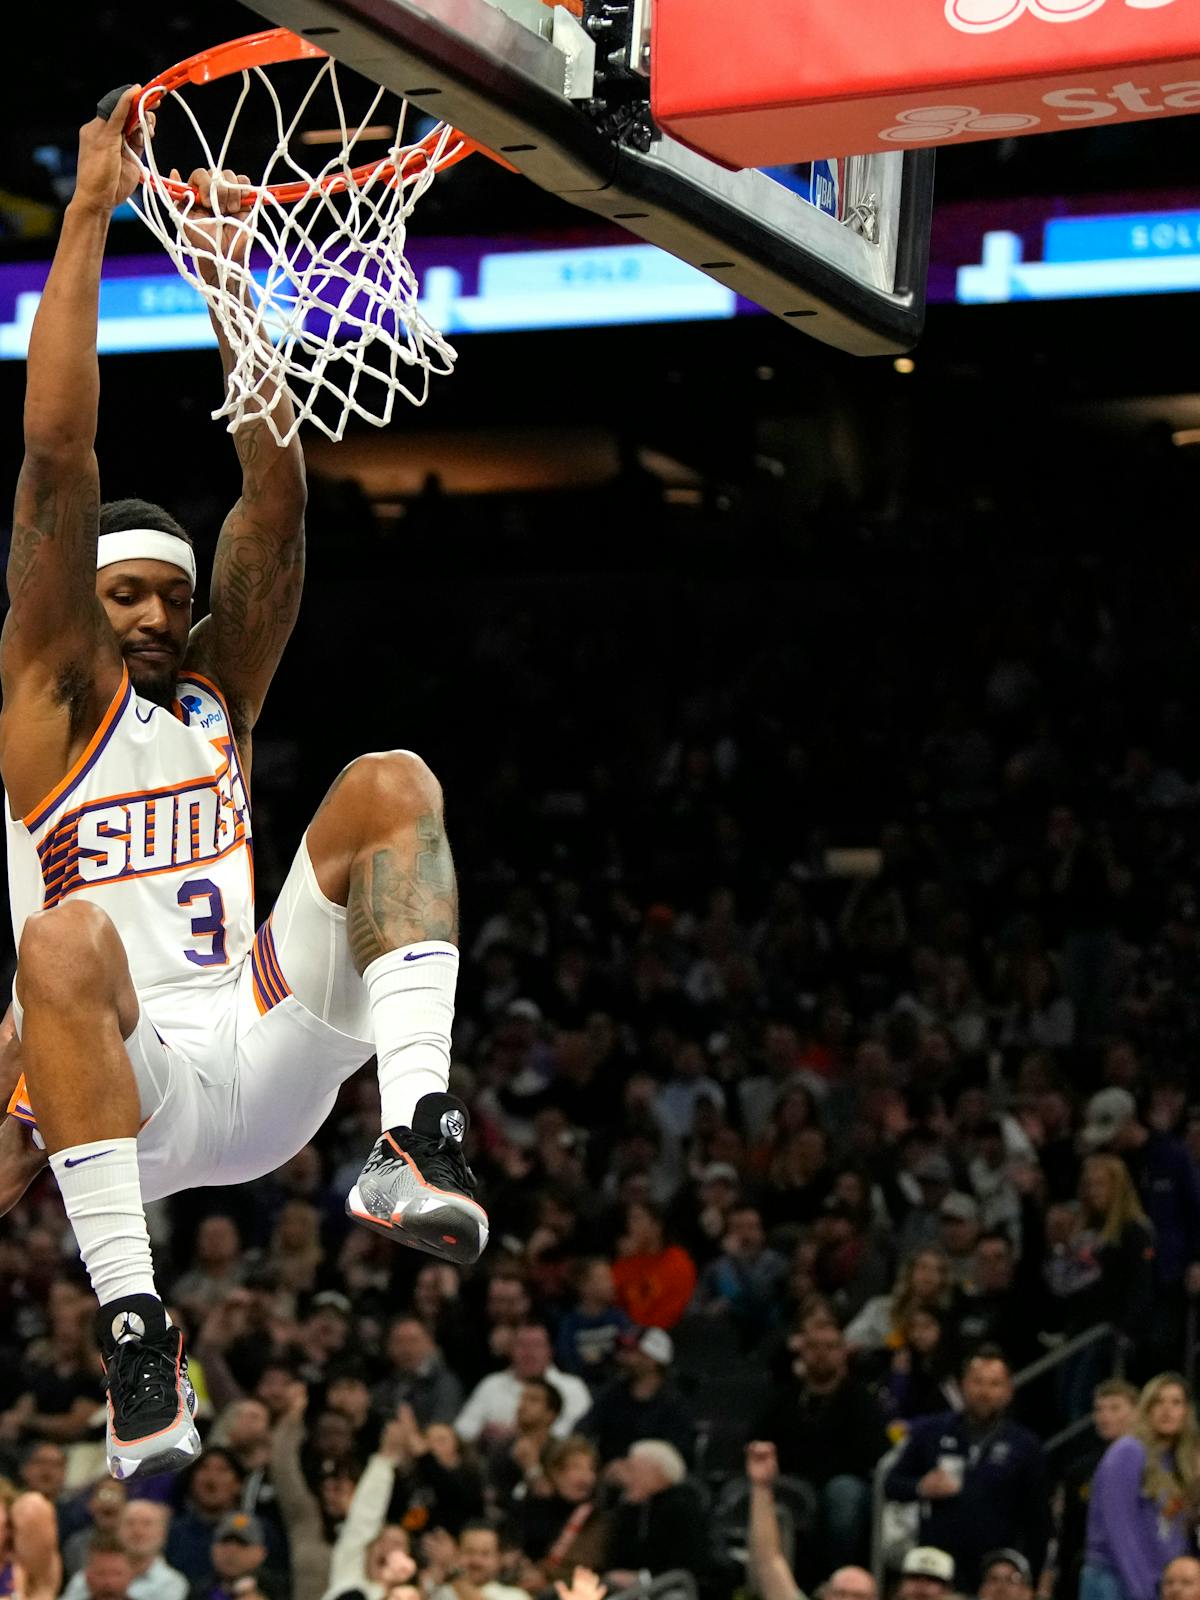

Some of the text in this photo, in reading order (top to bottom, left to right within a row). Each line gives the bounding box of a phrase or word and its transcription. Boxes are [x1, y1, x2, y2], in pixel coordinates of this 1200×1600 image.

[1131, 222, 1200, 249] SOL
[77, 772, 237, 882] SUNS
[177, 878, 230, 968] 3
